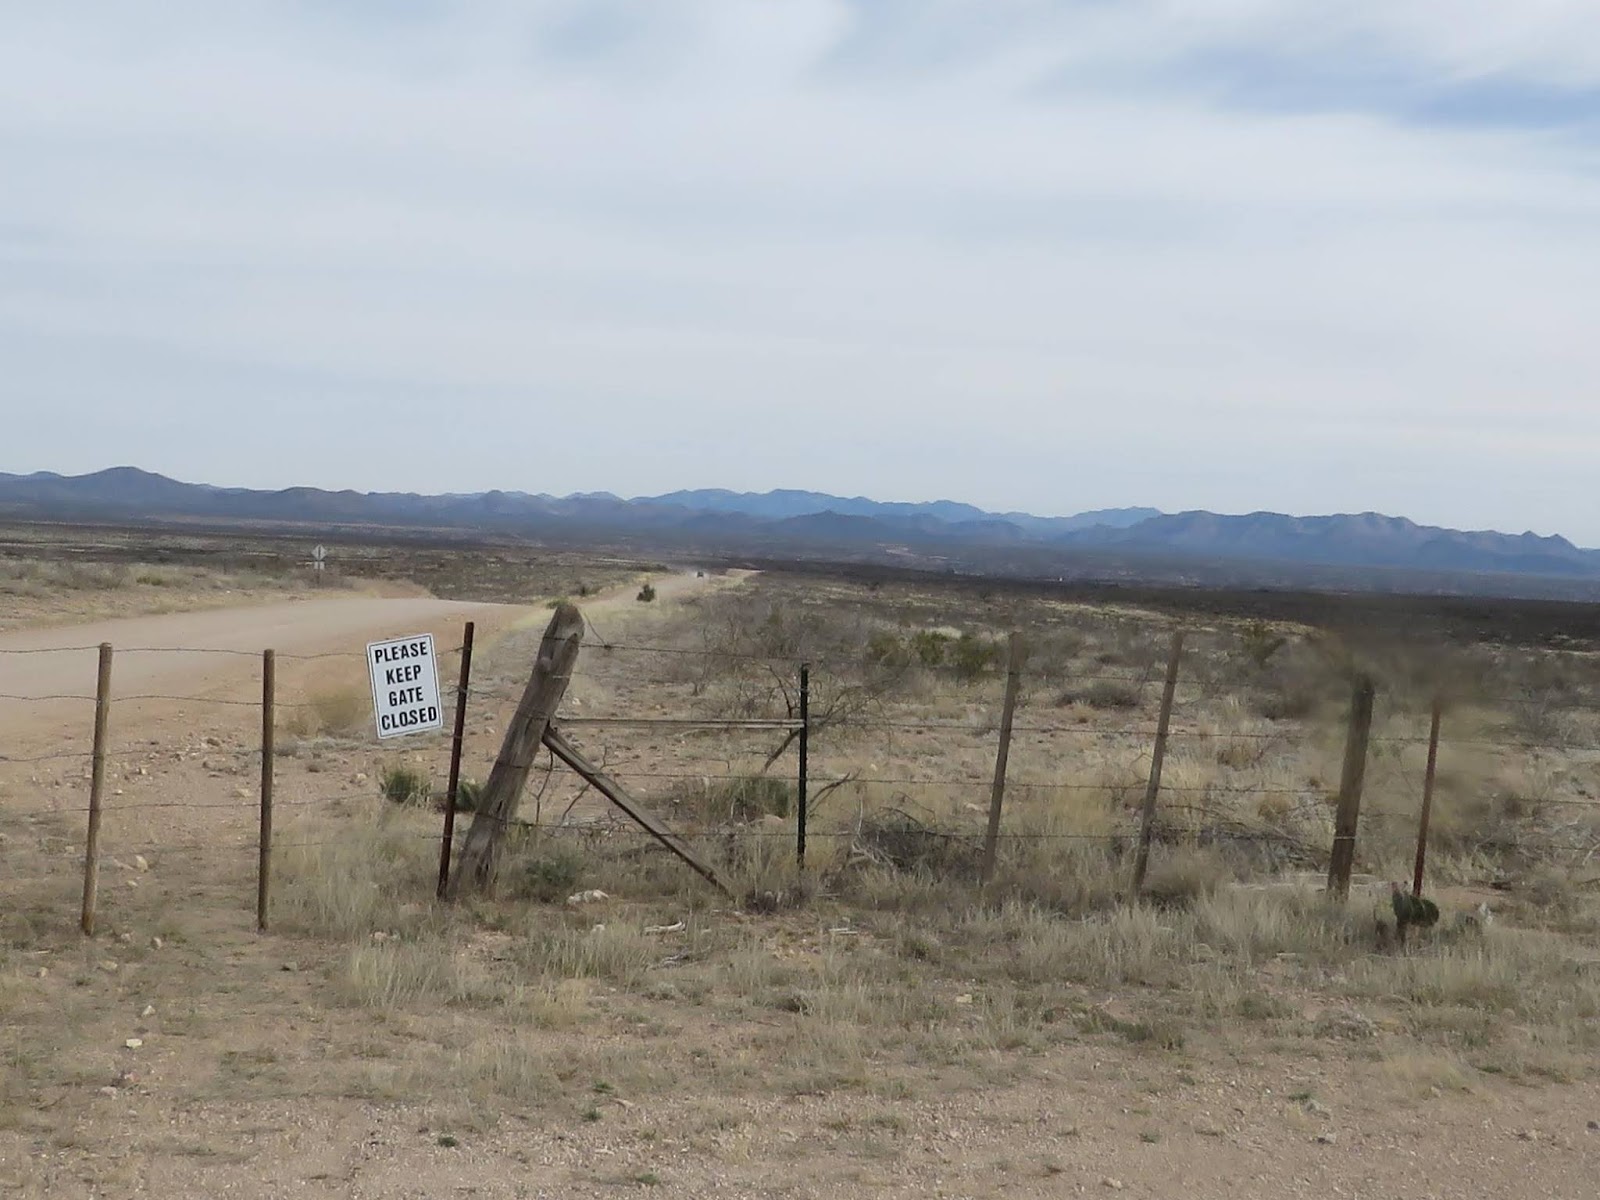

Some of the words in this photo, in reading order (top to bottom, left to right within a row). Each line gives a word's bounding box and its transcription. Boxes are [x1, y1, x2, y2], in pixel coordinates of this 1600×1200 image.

[374, 641, 428, 664] PLEASE
[386, 664, 421, 685] KEEP
[389, 686, 424, 707] GATE
[381, 706, 437, 730] CLOSED
